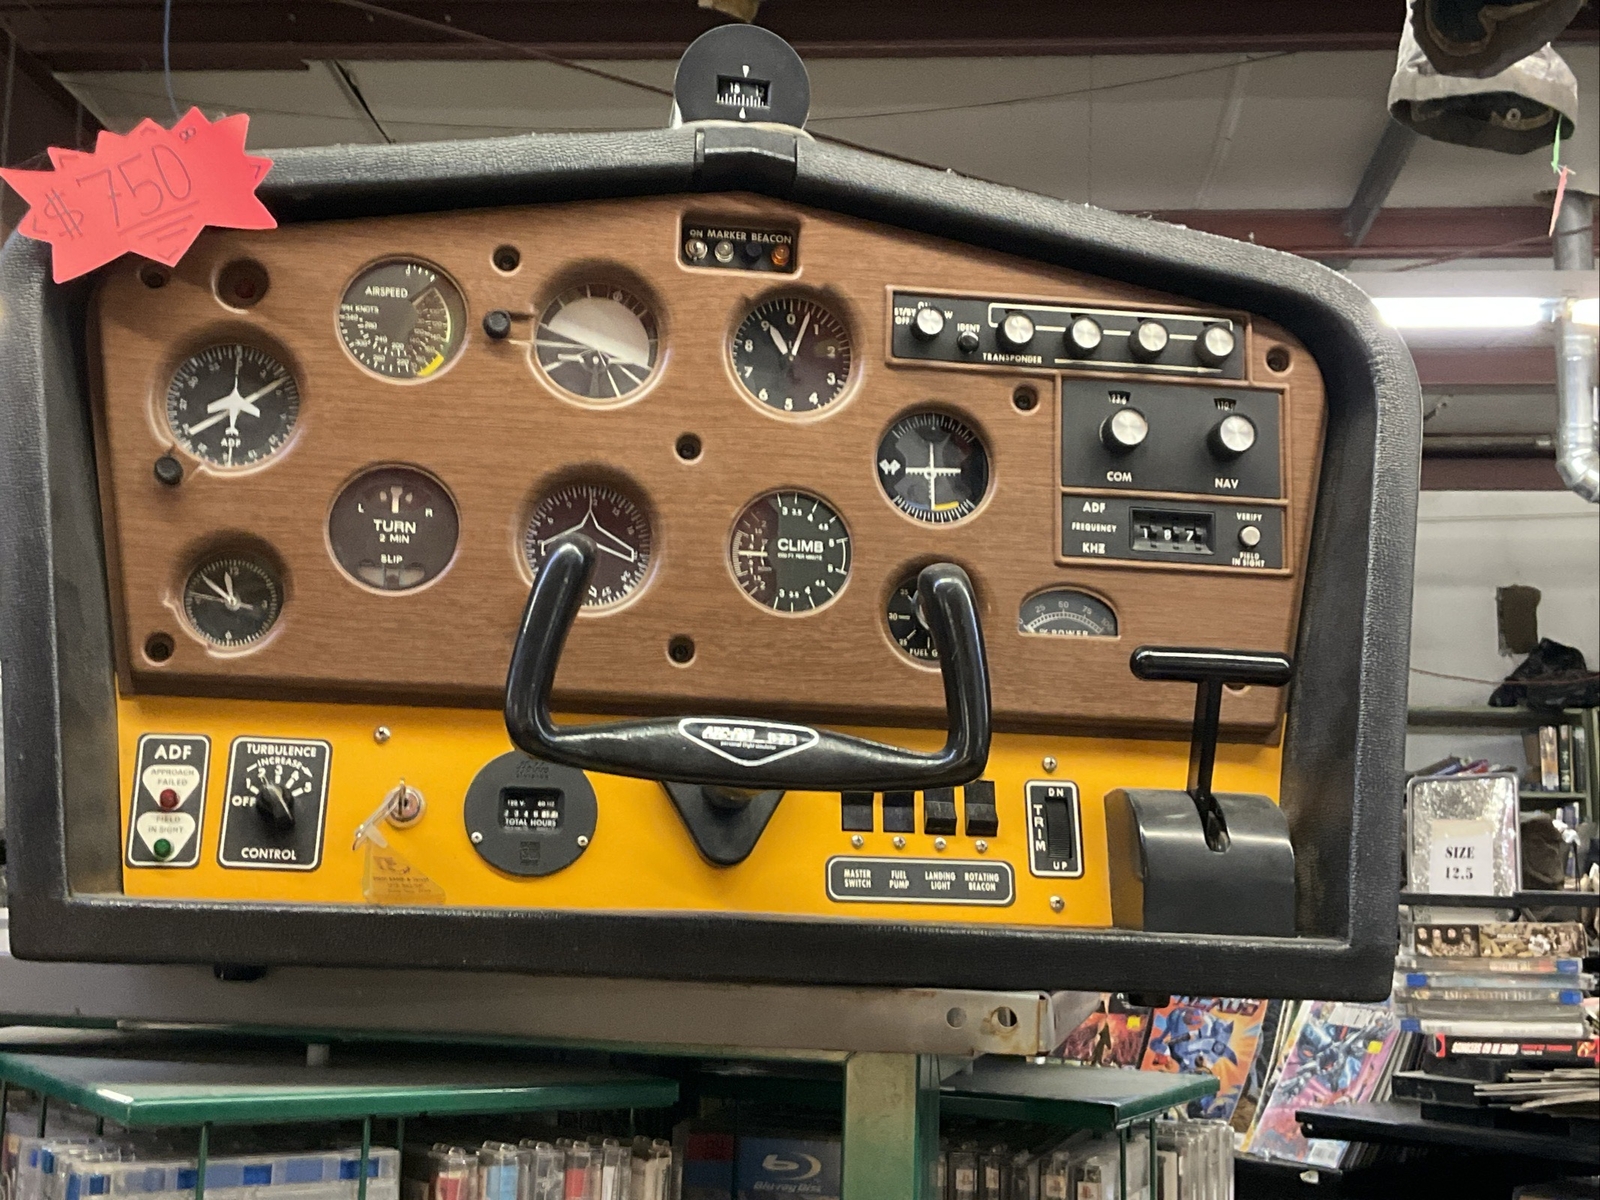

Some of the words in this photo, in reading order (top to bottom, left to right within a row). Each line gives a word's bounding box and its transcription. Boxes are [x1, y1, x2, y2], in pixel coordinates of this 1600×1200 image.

[43, 144, 192, 240] $750
[690, 229, 703, 238] ON
[707, 229, 747, 240] MARKER
[751, 232, 792, 244] BEACON
[365, 285, 408, 298] AIRSPEED
[786, 313, 796, 325] 0
[761, 320, 770, 331] 9
[814, 324, 819, 335] 1
[957, 323, 980, 333] IDENT
[745, 340, 753, 352] 8
[827, 346, 836, 358] 2
[983, 353, 1042, 364] TRANSPONDER
[744, 366, 753, 378] 7
[827, 372, 836, 385] 3
[758, 388, 768, 401] 6
[809, 392, 818, 405] 4
[1107, 471, 1132, 482] COM
[1215, 478, 1239, 489] NAV
[358, 503, 364, 513] L
[425, 508, 432, 517] R
[1083, 502, 1106, 514] ADF
[1237, 512, 1262, 522] VERIFY
[373, 519, 416, 534] TURN
[1071, 522, 1117, 533] FREQUENCY
[380, 534, 385, 542] 2
[390, 534, 409, 544] MIN
[777, 538, 824, 553] CLIMB
[1083, 543, 1106, 554] KHZ
[381, 554, 403, 564] SLIP
[1239, 552, 1260, 560] FIELD
[1232, 558, 1241, 566] IN
[1242, 559, 1265, 568] SIGHT
[1035, 605, 1046, 613] 25
[1082, 605, 1092, 615] 75
[909, 648, 929, 656] FUEL
[154, 744, 192, 760] ADF
[246, 743, 317, 758] TURBULENCE
[257, 757, 302, 769] INCREASE
[151, 768, 195, 776] APPROACH
[275, 765, 283, 775] 3
[291, 770, 300, 780] 4
[157, 779, 188, 787] FAILED
[304, 782, 312, 792] 5
[1048, 788, 1064, 797] DN
[232, 796, 257, 807] OFF
[505, 819, 527, 827] TOTAL
[530, 819, 556, 828] HOURS
[1033, 804, 1046, 852] TRIM
[159, 826, 183, 834] SIGHT
[241, 847, 297, 861] CONTROL
[1445, 846, 1475, 859] SIZE
[1053, 861, 1068, 870] UP
[844, 869, 871, 879] MASTER
[891, 870, 907, 880] FUEL
[925, 871, 956, 881] LANDING
[964, 872, 999, 883] ROTATING
[1445, 867, 1474, 880] 12.5
[844, 878, 872, 888] SWITCH
[889, 879, 909, 889] PUMP
[931, 881, 951, 891] LIGHT
[968, 882, 996, 891] BEACON
